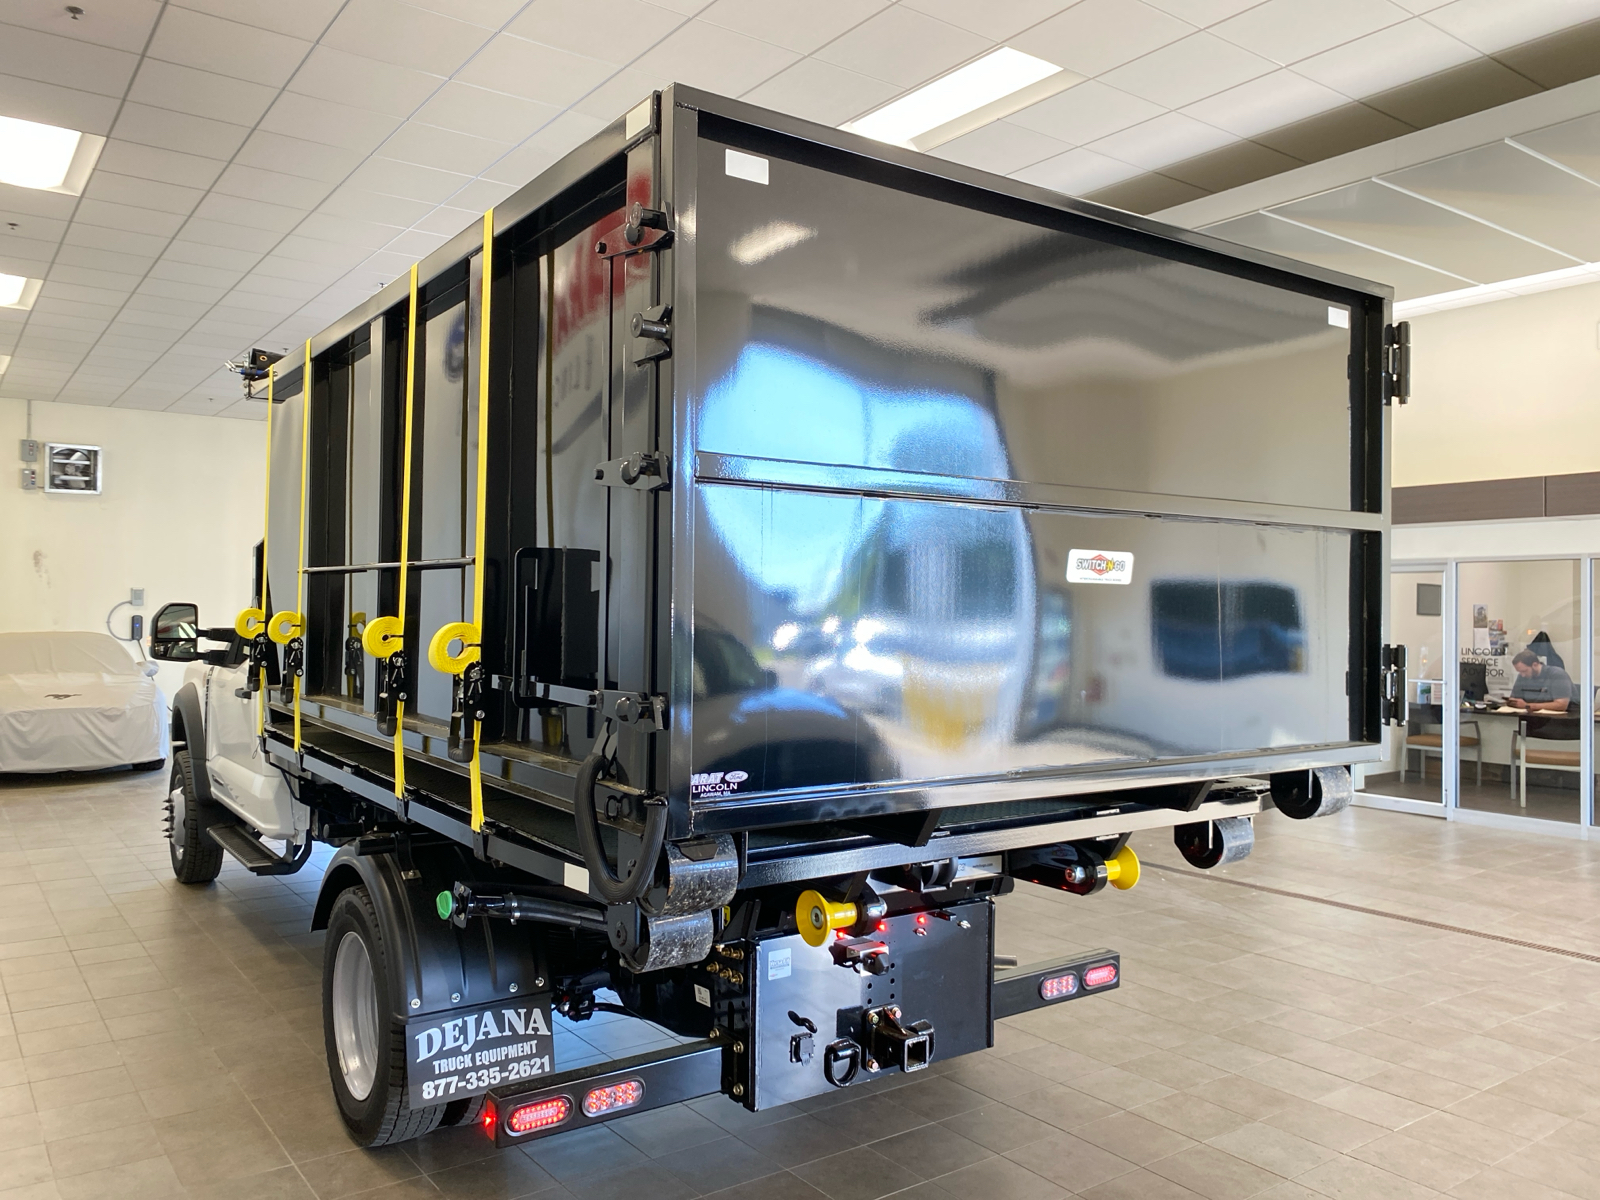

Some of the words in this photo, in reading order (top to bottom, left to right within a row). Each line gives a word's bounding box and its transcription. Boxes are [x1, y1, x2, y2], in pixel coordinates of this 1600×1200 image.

[1461, 668, 1505, 677] ADVSOR
[691, 772, 725, 785] ARAT
[692, 782, 738, 793] LINCOLN
[415, 1008, 551, 1062] DEJANA
[433, 1053, 473, 1075] TRUCK
[475, 1040, 538, 1066] EQUIPMENT
[422, 1055, 550, 1100] 877-335-2621
